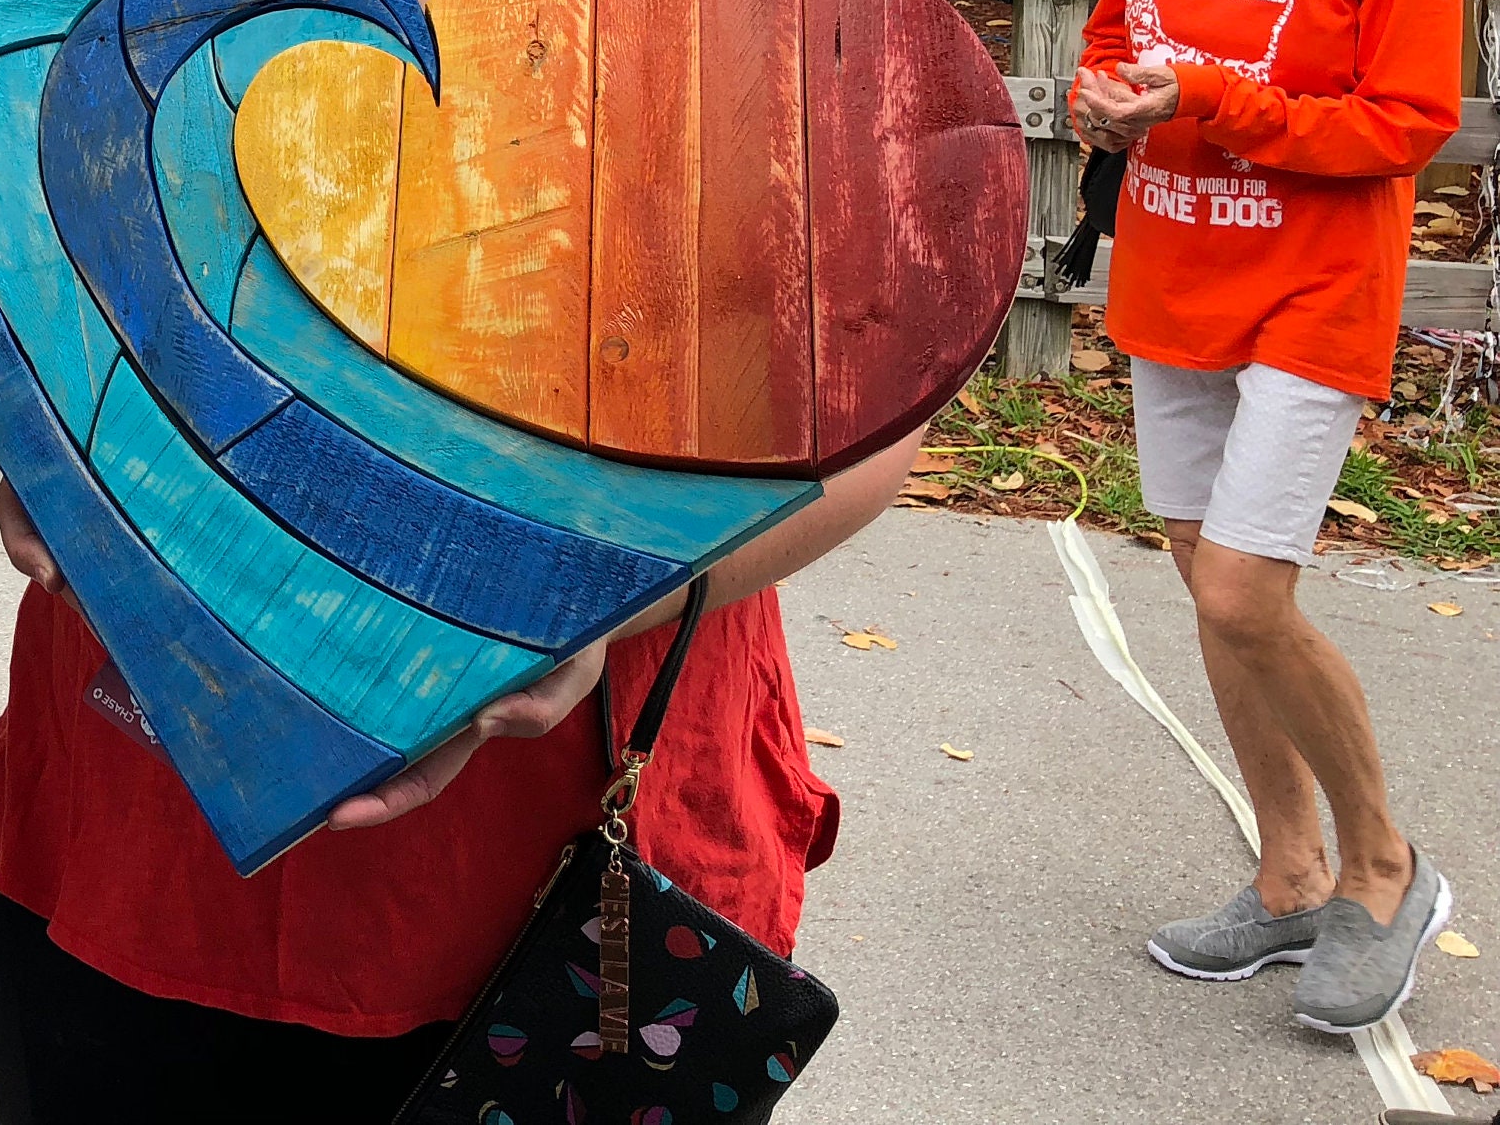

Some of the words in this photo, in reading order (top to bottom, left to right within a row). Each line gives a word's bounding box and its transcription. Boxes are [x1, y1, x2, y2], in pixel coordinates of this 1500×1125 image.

[1139, 162, 1171, 187] CHANGE
[1173, 173, 1192, 193] THE
[1195, 177, 1239, 195] WORLD
[1243, 179, 1267, 196] FOR
[1143, 183, 1197, 224] ONE
[1209, 195, 1283, 228] DOG
[101, 694, 135, 723] CHASE
